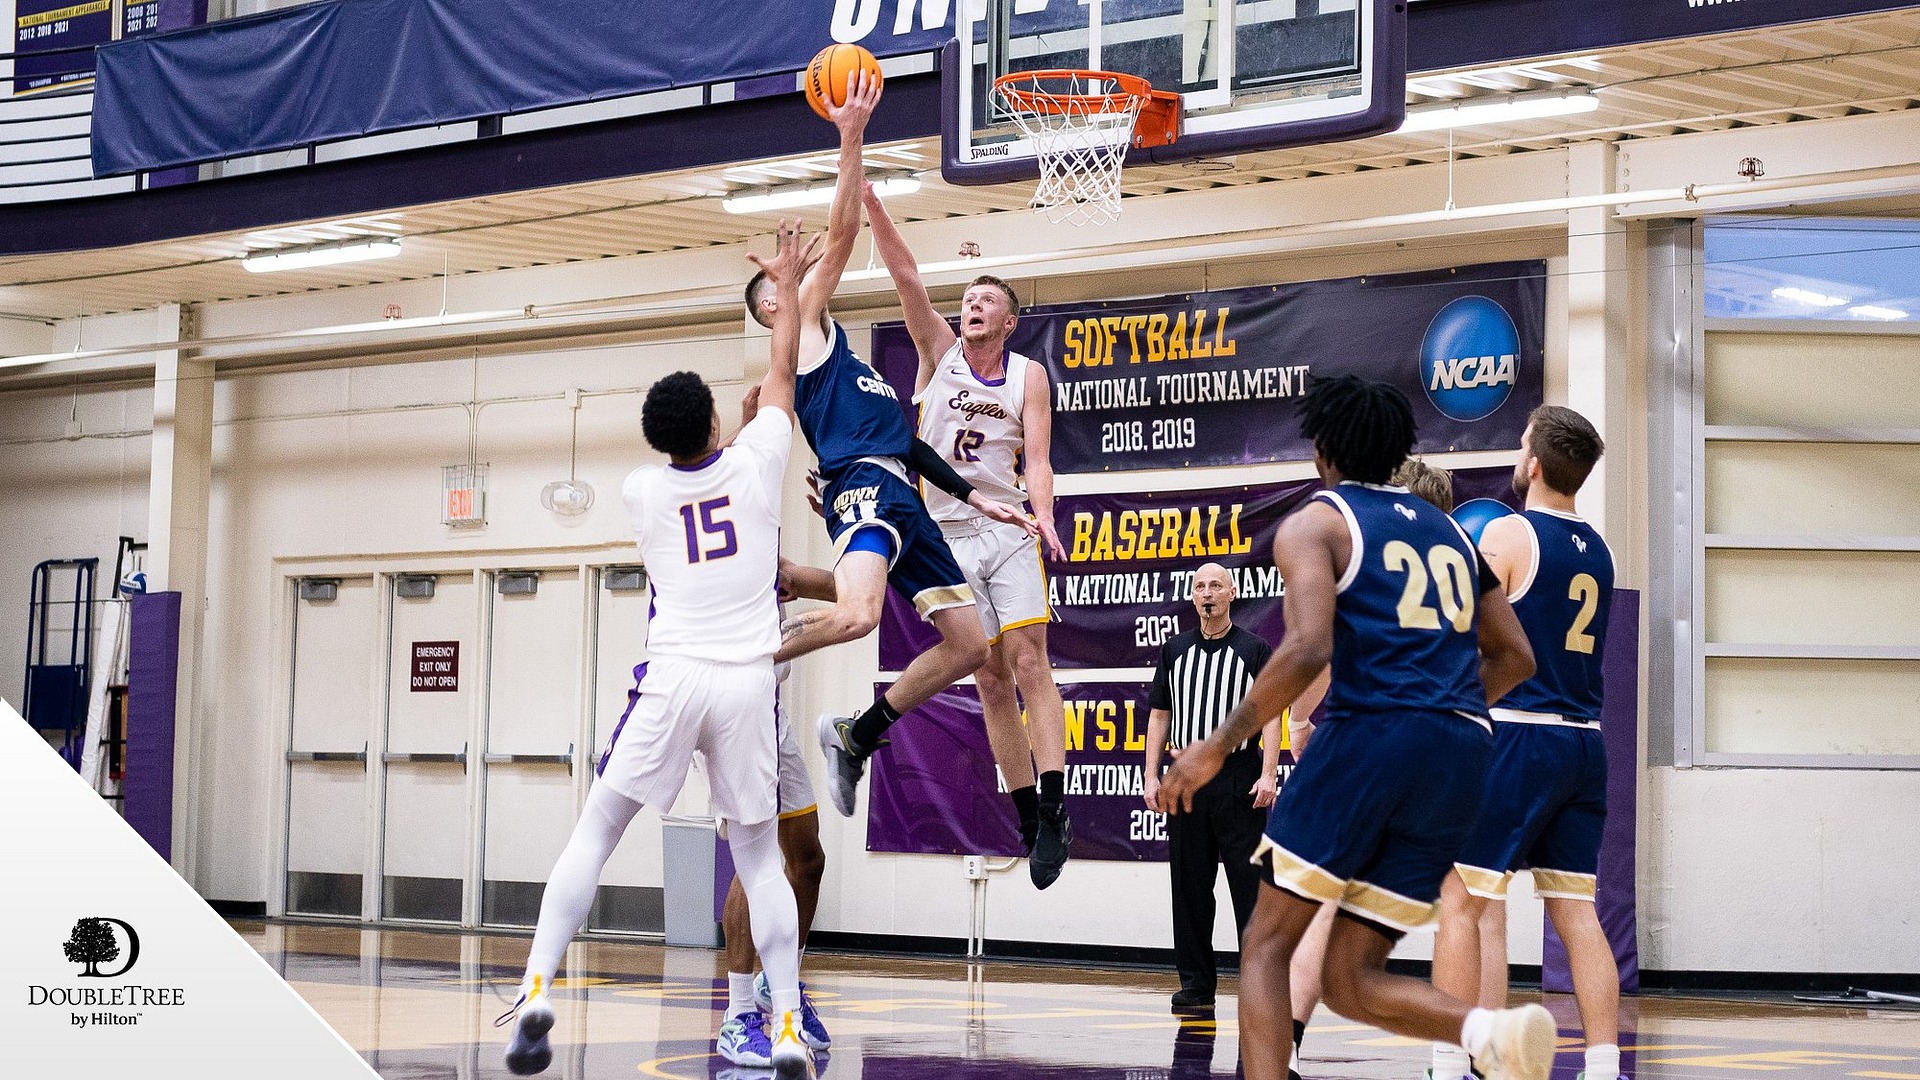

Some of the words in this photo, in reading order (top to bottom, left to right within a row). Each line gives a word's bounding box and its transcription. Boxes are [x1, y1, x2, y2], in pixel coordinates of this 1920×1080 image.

[146, 3, 158, 16] 201
[20, 27, 35, 41] 2012
[54, 20, 69, 35] 2021
[970, 143, 1009, 160] SPALDING
[1063, 307, 1236, 368] SOFTBALL
[1056, 377, 1151, 412] NATIONAL
[1157, 365, 1310, 405] TOURNAMENT
[1430, 354, 1515, 391] NCAA
[948, 390, 1007, 421] Eagles
[953, 428, 986, 463] 12
[1152, 417, 1196, 450] 2019
[678, 494, 738, 564] 15
[1070, 504, 1252, 562] BASEBALL
[1065, 572, 1165, 606] NATIONAL
[1383, 540, 1475, 634] 20
[1565, 572, 1600, 655] 2
[1135, 615, 1180, 647] 2021
[416, 646, 455, 658] EMERGENCY
[419, 661, 434, 672] EXIT
[434, 661, 452, 672] ONLY
[412, 676, 423, 687] DO
[423, 676, 437, 687] NOT
[438, 676, 457, 687] OPEN
[1130, 809, 1169, 841] 202
